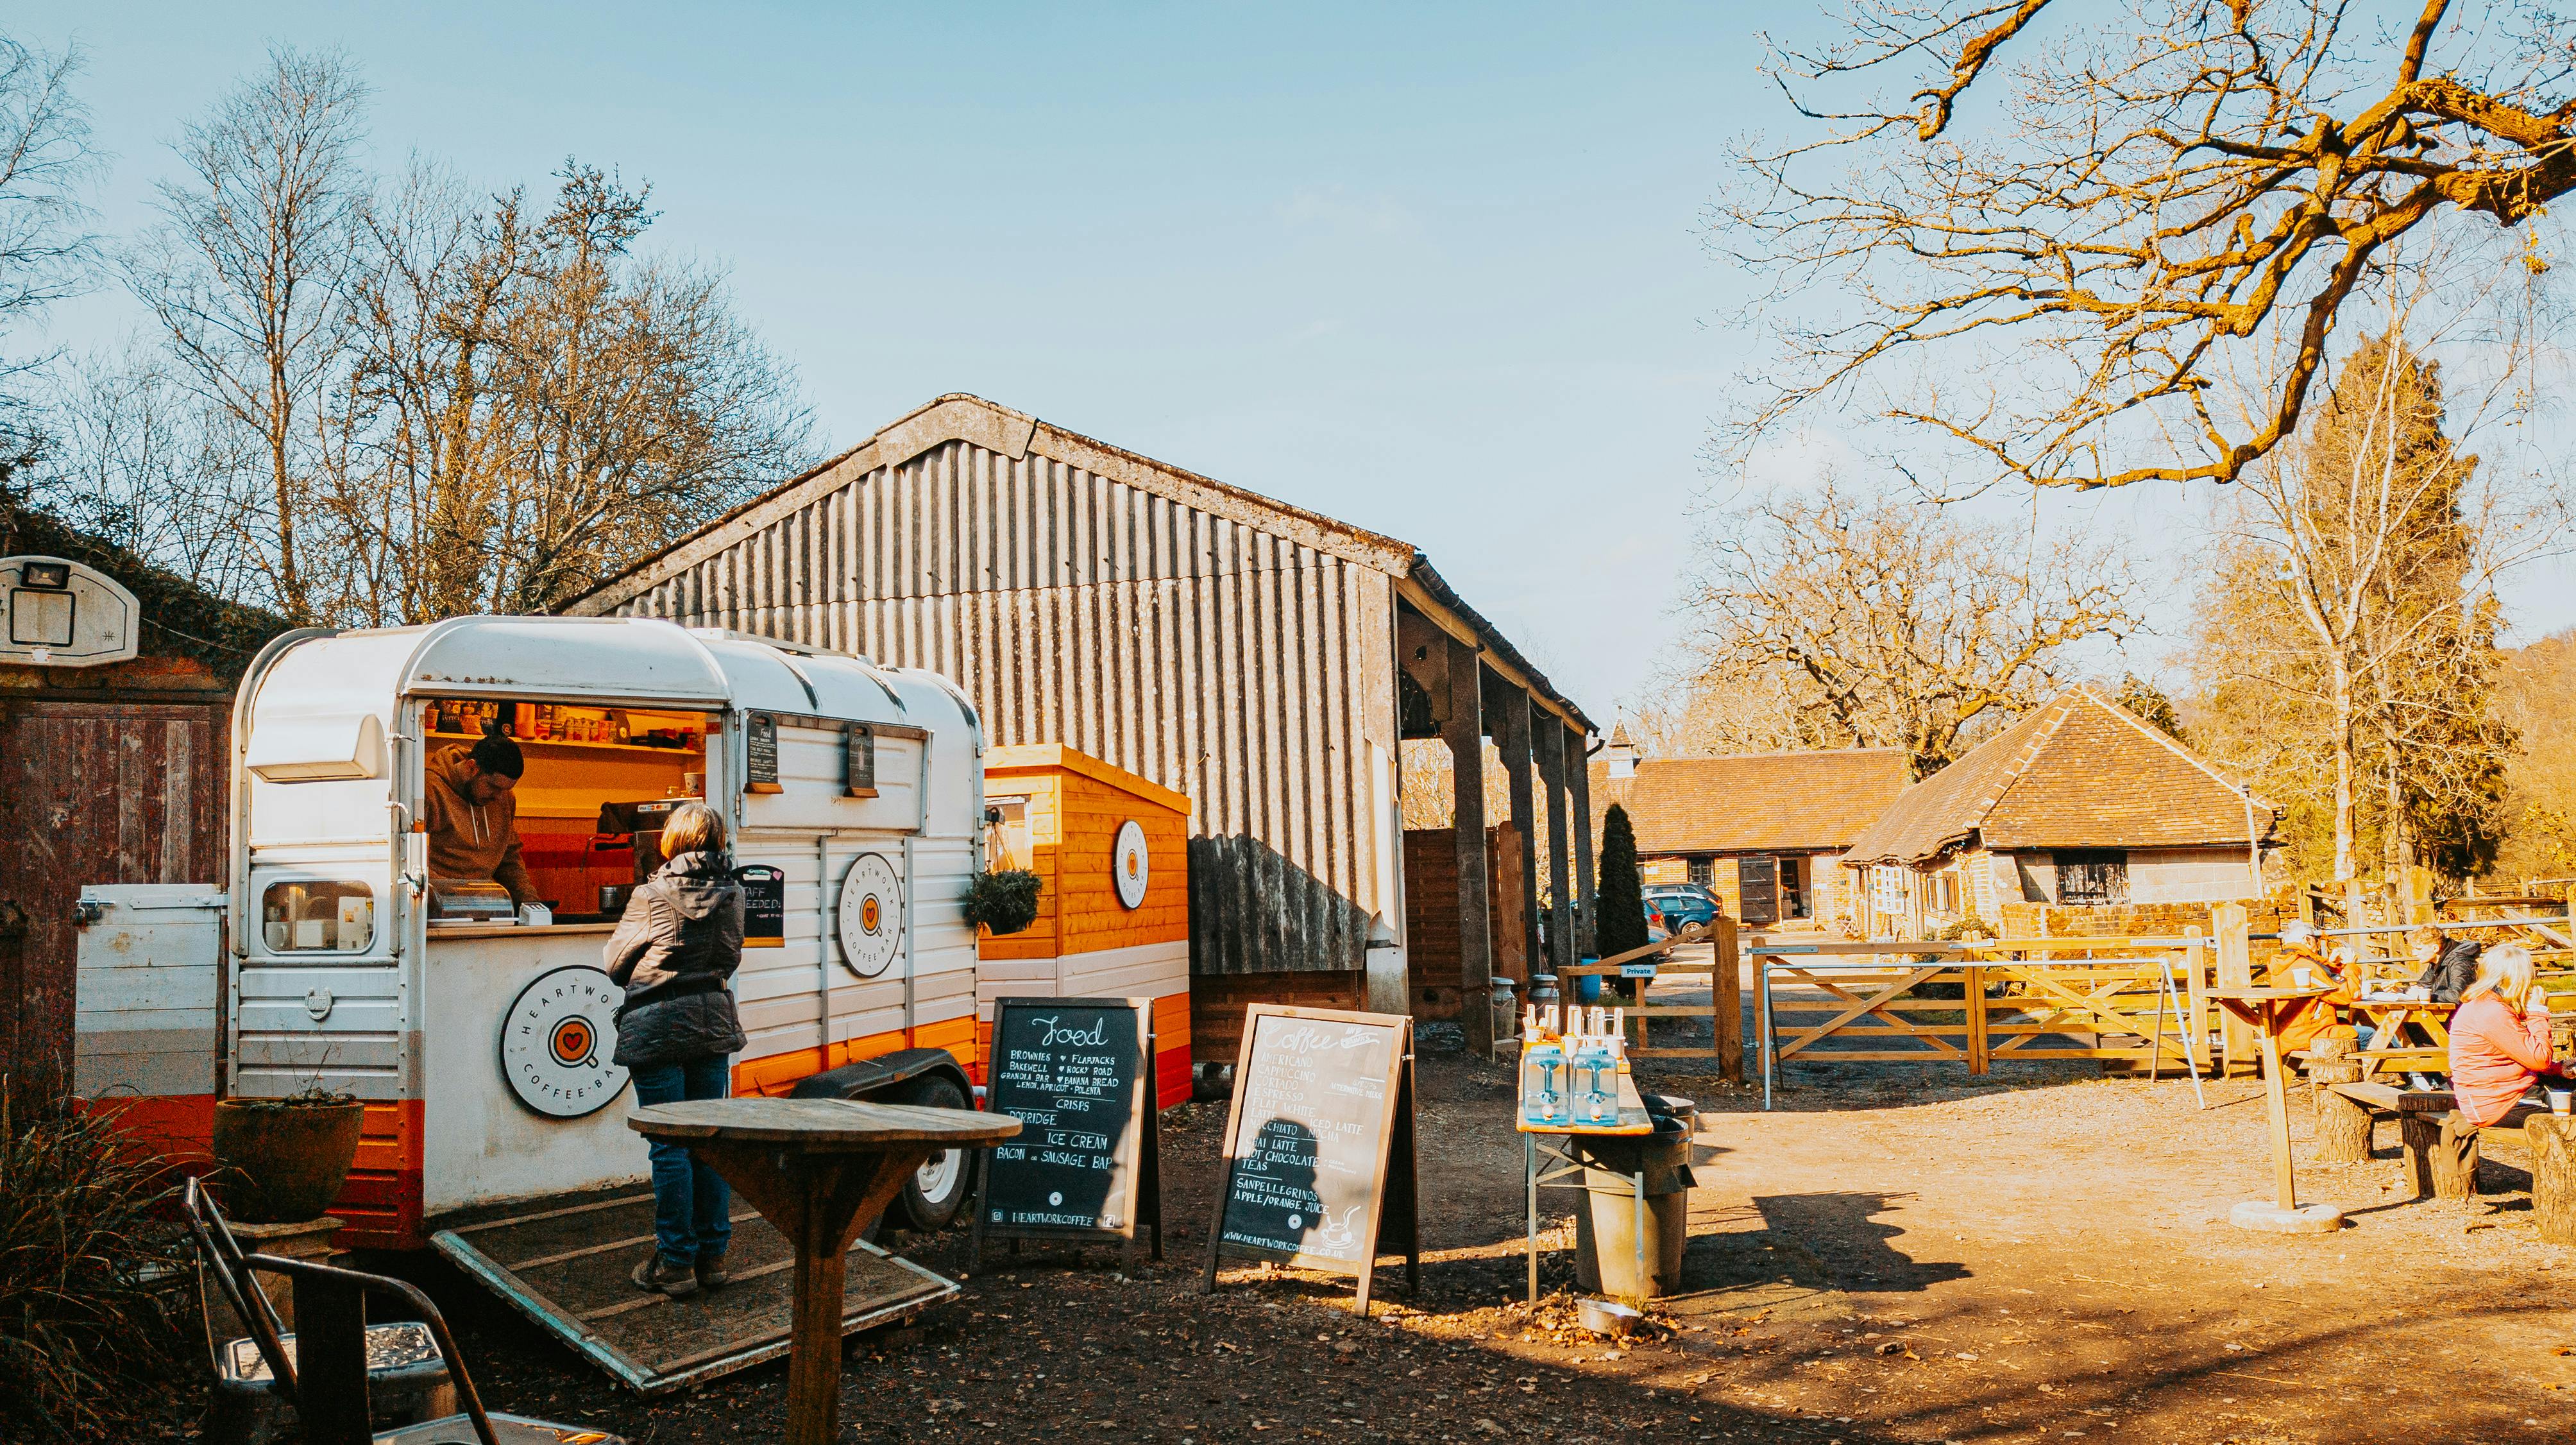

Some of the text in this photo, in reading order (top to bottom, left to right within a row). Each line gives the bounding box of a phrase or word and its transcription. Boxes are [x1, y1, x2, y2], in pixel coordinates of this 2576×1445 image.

[847, 868, 894, 908] HEARTWORK
[521, 985, 609, 1035] HEARTWO
[1032, 1016, 1108, 1046] Food
[1262, 1024, 1339, 1054] Coffee
[1010, 1050, 1115, 1065] BROWNIES FLAPJACKS
[1262, 1052, 1313, 1067] AMERICANO
[1010, 1061, 1113, 1075] BAKEWELL ROCKY ROAD
[1258, 1065, 1316, 1082] CAPPUCCINO
[524, 1063, 613, 1099] COFFEE-BA
[1001, 1072, 1119, 1087] GRANOLA BAR BANANA BREAD
[1255, 1076, 1298, 1090] CORTADO
[1074, 1086, 1101, 1095] POLENTA
[1254, 1087, 1304, 1101] ESPRESSO
[1056, 1099, 1090, 1111] CRISPS
[1253, 1097, 1316, 1117] FLAT WHITE
[1010, 1111, 1057, 1125] PORRIDGE
[1251, 1107, 1278, 1122] LATTE
[1249, 1118, 1339, 1143] MACCHIATO MOCHA
[1309, 1118, 1364, 1135] ICED LATTE
[1047, 1132, 1108, 1150] ICE CREAM
[1246, 1134, 1298, 1152] CHAI LATTE
[996, 1147, 1026, 1160] BACON
[1040, 1150, 1086, 1168] SAUSAGE
[1092, 1156, 1113, 1170] BAP
[1242, 1159, 1267, 1171] TEAS
[1244, 1147, 1320, 1168] HOT CHOCOLATE
[1237, 1177, 1318, 1202] SANPELLEGRINOS
[1234, 1190, 1330, 1215] APPLE/ORANGE JUICE
[1223, 1231, 1344, 1259] WWW.HEARTWORKCOFFEE.CO.UK
